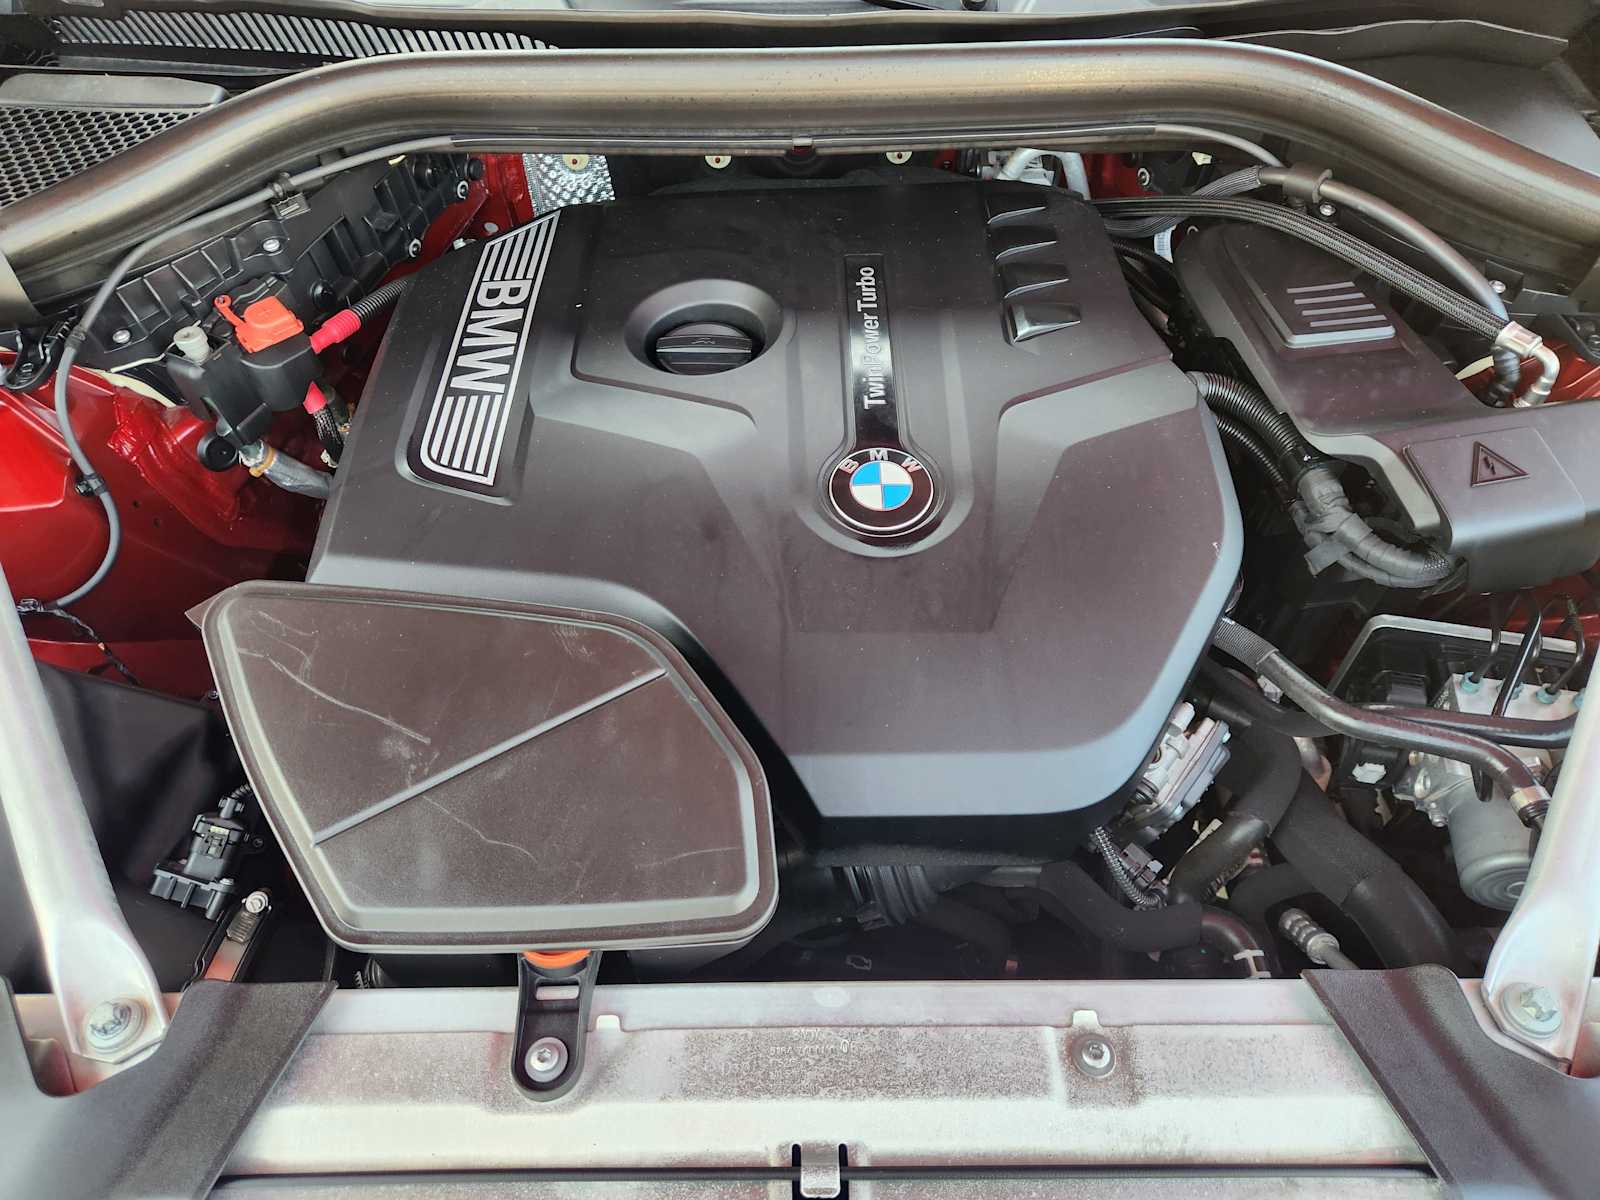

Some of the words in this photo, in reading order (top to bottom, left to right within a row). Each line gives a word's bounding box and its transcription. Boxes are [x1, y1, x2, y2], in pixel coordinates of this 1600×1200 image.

[856, 267, 878, 312] Turbo
[450, 280, 532, 393] BMW
[863, 312, 887, 410] TwinPower
[839, 449, 922, 474] BMW
